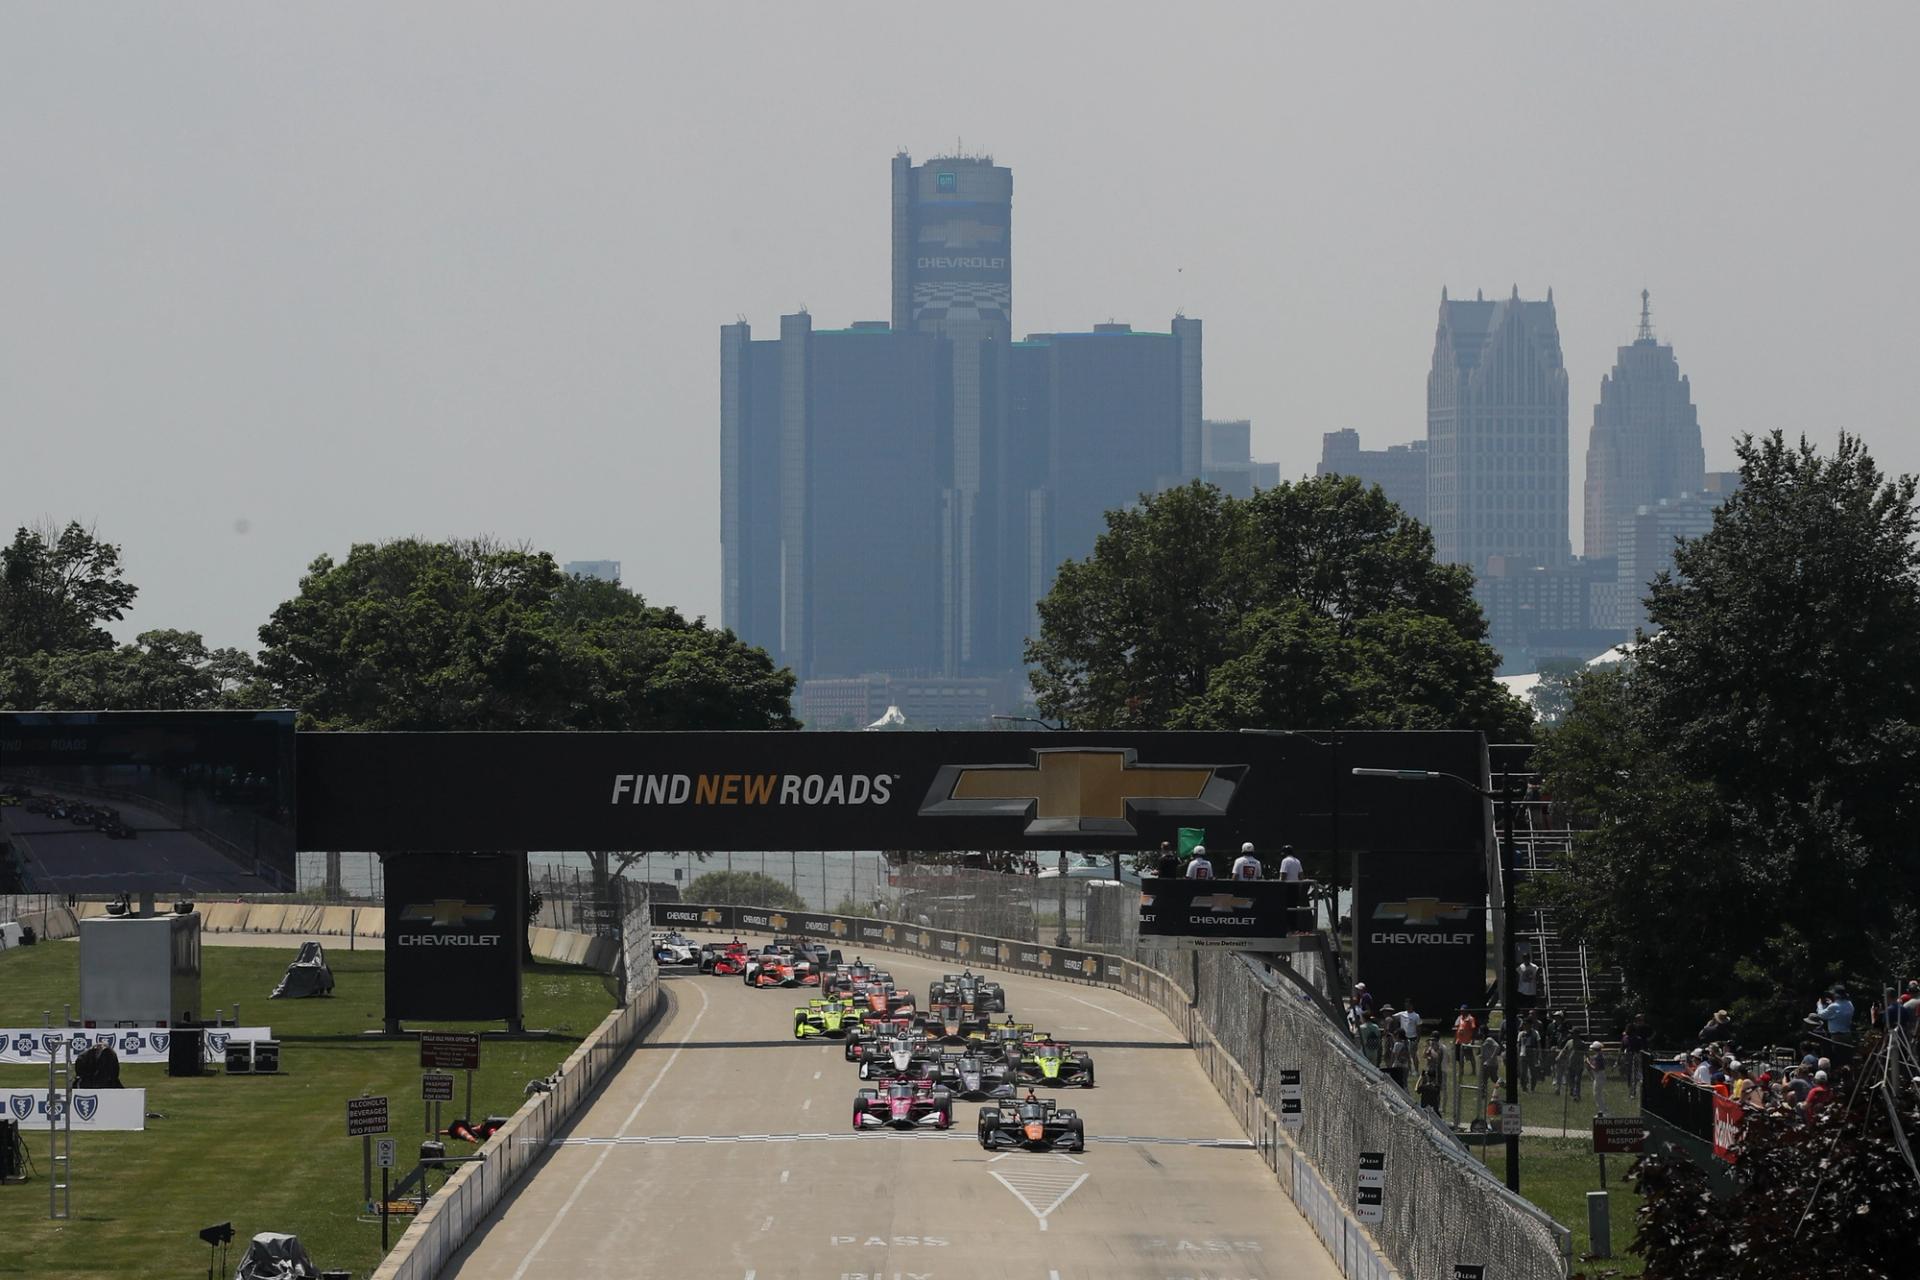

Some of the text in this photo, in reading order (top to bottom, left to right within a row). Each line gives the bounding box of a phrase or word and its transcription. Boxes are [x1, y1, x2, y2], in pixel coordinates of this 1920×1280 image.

[918, 257, 1006, 269] CHEVROLET
[611, 773, 691, 804] FIND
[695, 773, 776, 804] NEW
[667, 911, 699, 921] CHEVROLET
[1190, 916, 1256, 925] CHEVROLET
[398, 935, 501, 946] CHEVROLET
[1371, 933, 1474, 945] CHEVROLET
[350, 1099, 386, 1108] ALCOHOLIC
[350, 1108, 386, 1117] BEVERAGES
[350, 1117, 387, 1126] PROHIBITED
[364, 1125, 386, 1133] PERMIT
[831, 1236, 951, 1247] PASS
